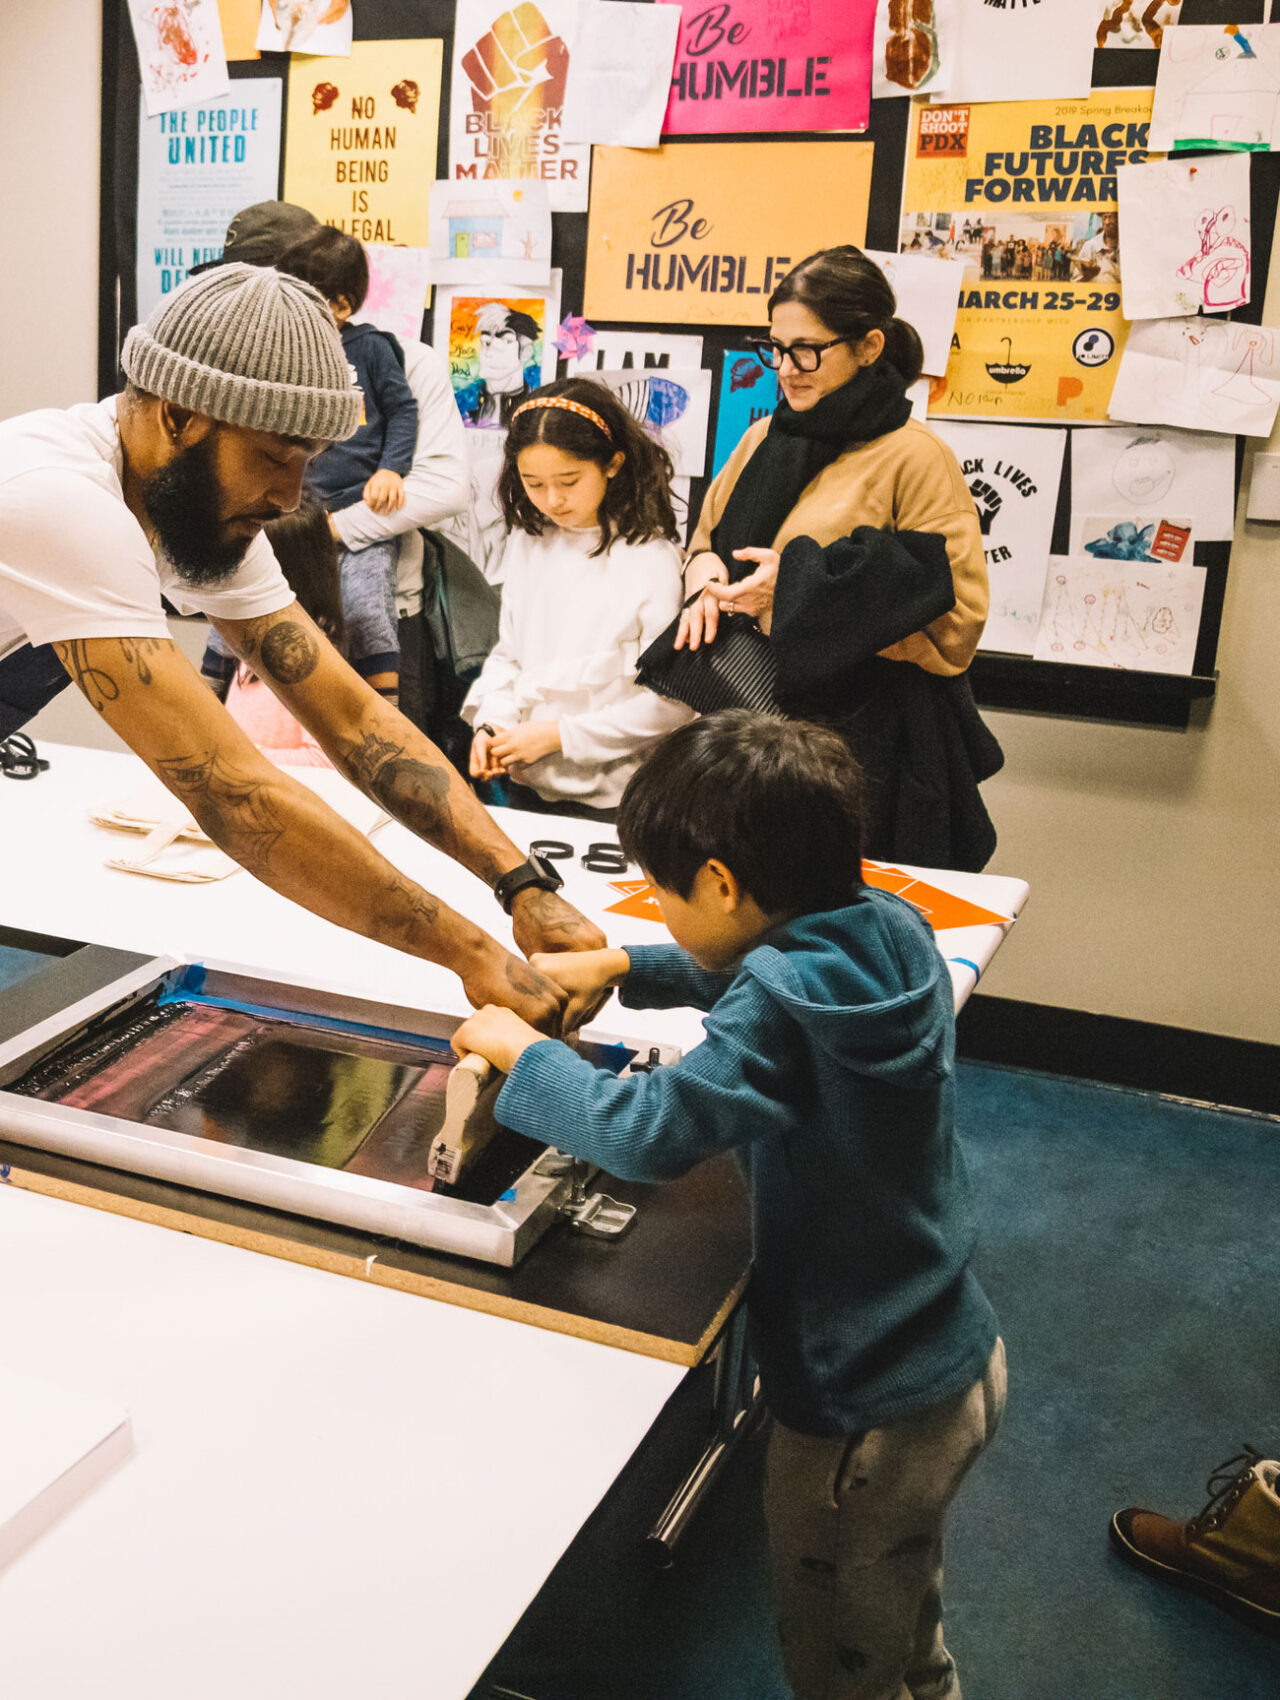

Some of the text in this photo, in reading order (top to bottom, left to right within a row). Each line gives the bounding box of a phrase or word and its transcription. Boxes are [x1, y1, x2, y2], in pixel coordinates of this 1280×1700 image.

[686, 4, 752, 57] Be
[351, 96, 375, 119] NO
[921, 110, 968, 122] DON'T
[1080, 105, 1111, 117] Spring
[160, 108, 258, 133] THE PEOPLE
[466, 108, 563, 134] BLACK
[921, 122, 967, 134] SHOOT
[330, 126, 396, 150] HUMAN
[474, 134, 560, 158] LIVES
[920, 134, 966, 151] PDX
[1030, 123, 1151, 149] BLACK
[168, 134, 246, 164] UNITED
[336, 160, 388, 183] BEING
[456, 159, 579, 180] MATTER
[352, 190, 369, 213] IS
[965, 177, 1118, 203] FORWAR
[650, 199, 715, 248] Be
[154, 247, 184, 266] WILL
[626, 253, 792, 294] HUMBLE
[1043, 292, 1121, 311] 25-29
[994, 461, 1038, 498] LIVES
